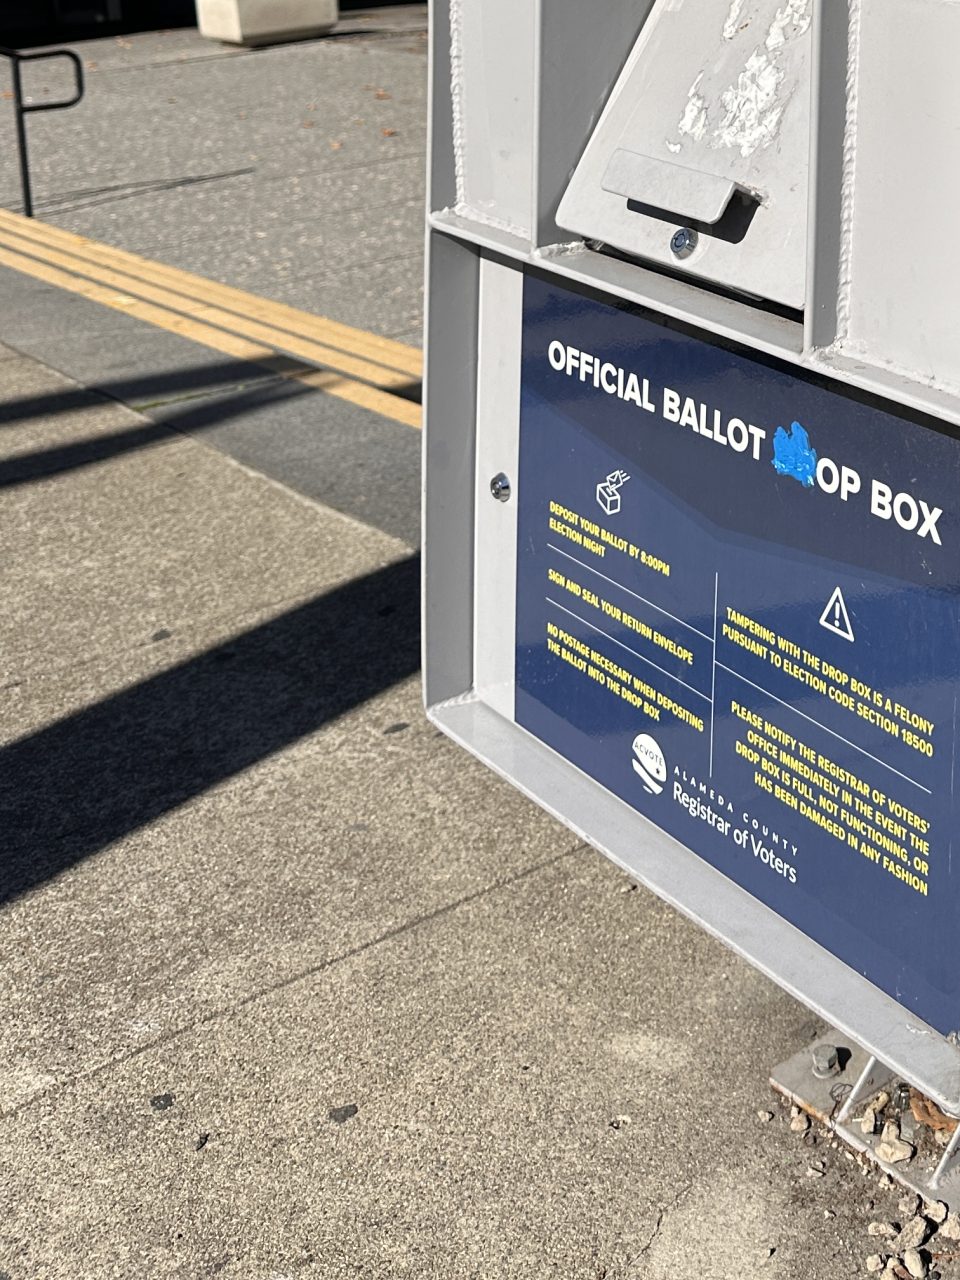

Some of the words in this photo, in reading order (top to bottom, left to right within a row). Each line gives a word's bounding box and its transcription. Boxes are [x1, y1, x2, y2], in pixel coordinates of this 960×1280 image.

[548, 340, 655, 412] OFFICIAL
[662, 388, 765, 459] BALLOT
[870, 479, 942, 545] BOX
[548, 517, 582, 544] ELECTION
[582, 535, 605, 557] NIGHT
[549, 500, 578, 525] DEPOSIT
[579, 516, 600, 537] YOUR
[600, 528, 628, 552] BALLOT
[628, 543, 639, 559] BY
[640, 550, 670, 576] 8:00PM
[722, 623, 767, 659] PURSUANT
[769, 650, 782, 668] TO
[782, 658, 827, 694] ELECTION
[828, 685, 855, 711] CODE
[856, 702, 899, 737] SECTION
[901, 728, 933, 757] 18500
[726, 606, 776, 645] TAMPERING
[777, 635, 801, 660] WITH
[802, 649, 820, 671] THE
[821, 661, 848, 686] DROP
[850, 677, 871, 701] BOX
[872, 690, 883, 707] IS
[884, 698, 892, 713] A
[893, 702, 933, 736] FELONY
[673, 765, 733, 813] ALAMEDA
[742, 812, 798, 856] COUNTY
[731, 700, 763, 730] PLEASE
[764, 721, 796, 750] NOTIFY
[798, 742, 816, 764] THE
[817, 754, 870, 798] REGISTRAR
[871, 789, 886, 806] OF
[735, 740, 760, 764] DROP
[761, 756, 780, 779] BOX
[781, 769, 791, 786] IS
[792, 776, 817, 805] FULL,
[818, 794, 838, 817] NOT
[840, 808, 911, 866] FUNCTIONING,
[913, 856, 929, 876] OR
[746, 729, 778, 759] OFFICE
[779, 749, 839, 797] IMMEDIATELY
[841, 789, 852, 807] IN
[854, 797, 873, 820] THE
[874, 810, 906, 841] EVENT
[909, 832, 929, 856] THE
[673, 781, 730, 835] Registrar
[733, 828, 748, 848] of
[750, 834, 796, 883] Voters
[754, 771, 773, 793] HAS
[774, 784, 798, 810] BEEN
[799, 801, 845, 840] DAMAGED
[847, 832, 858, 850] IN
[859, 841, 881, 864] ANY
[882, 855, 928, 896] FASHION
